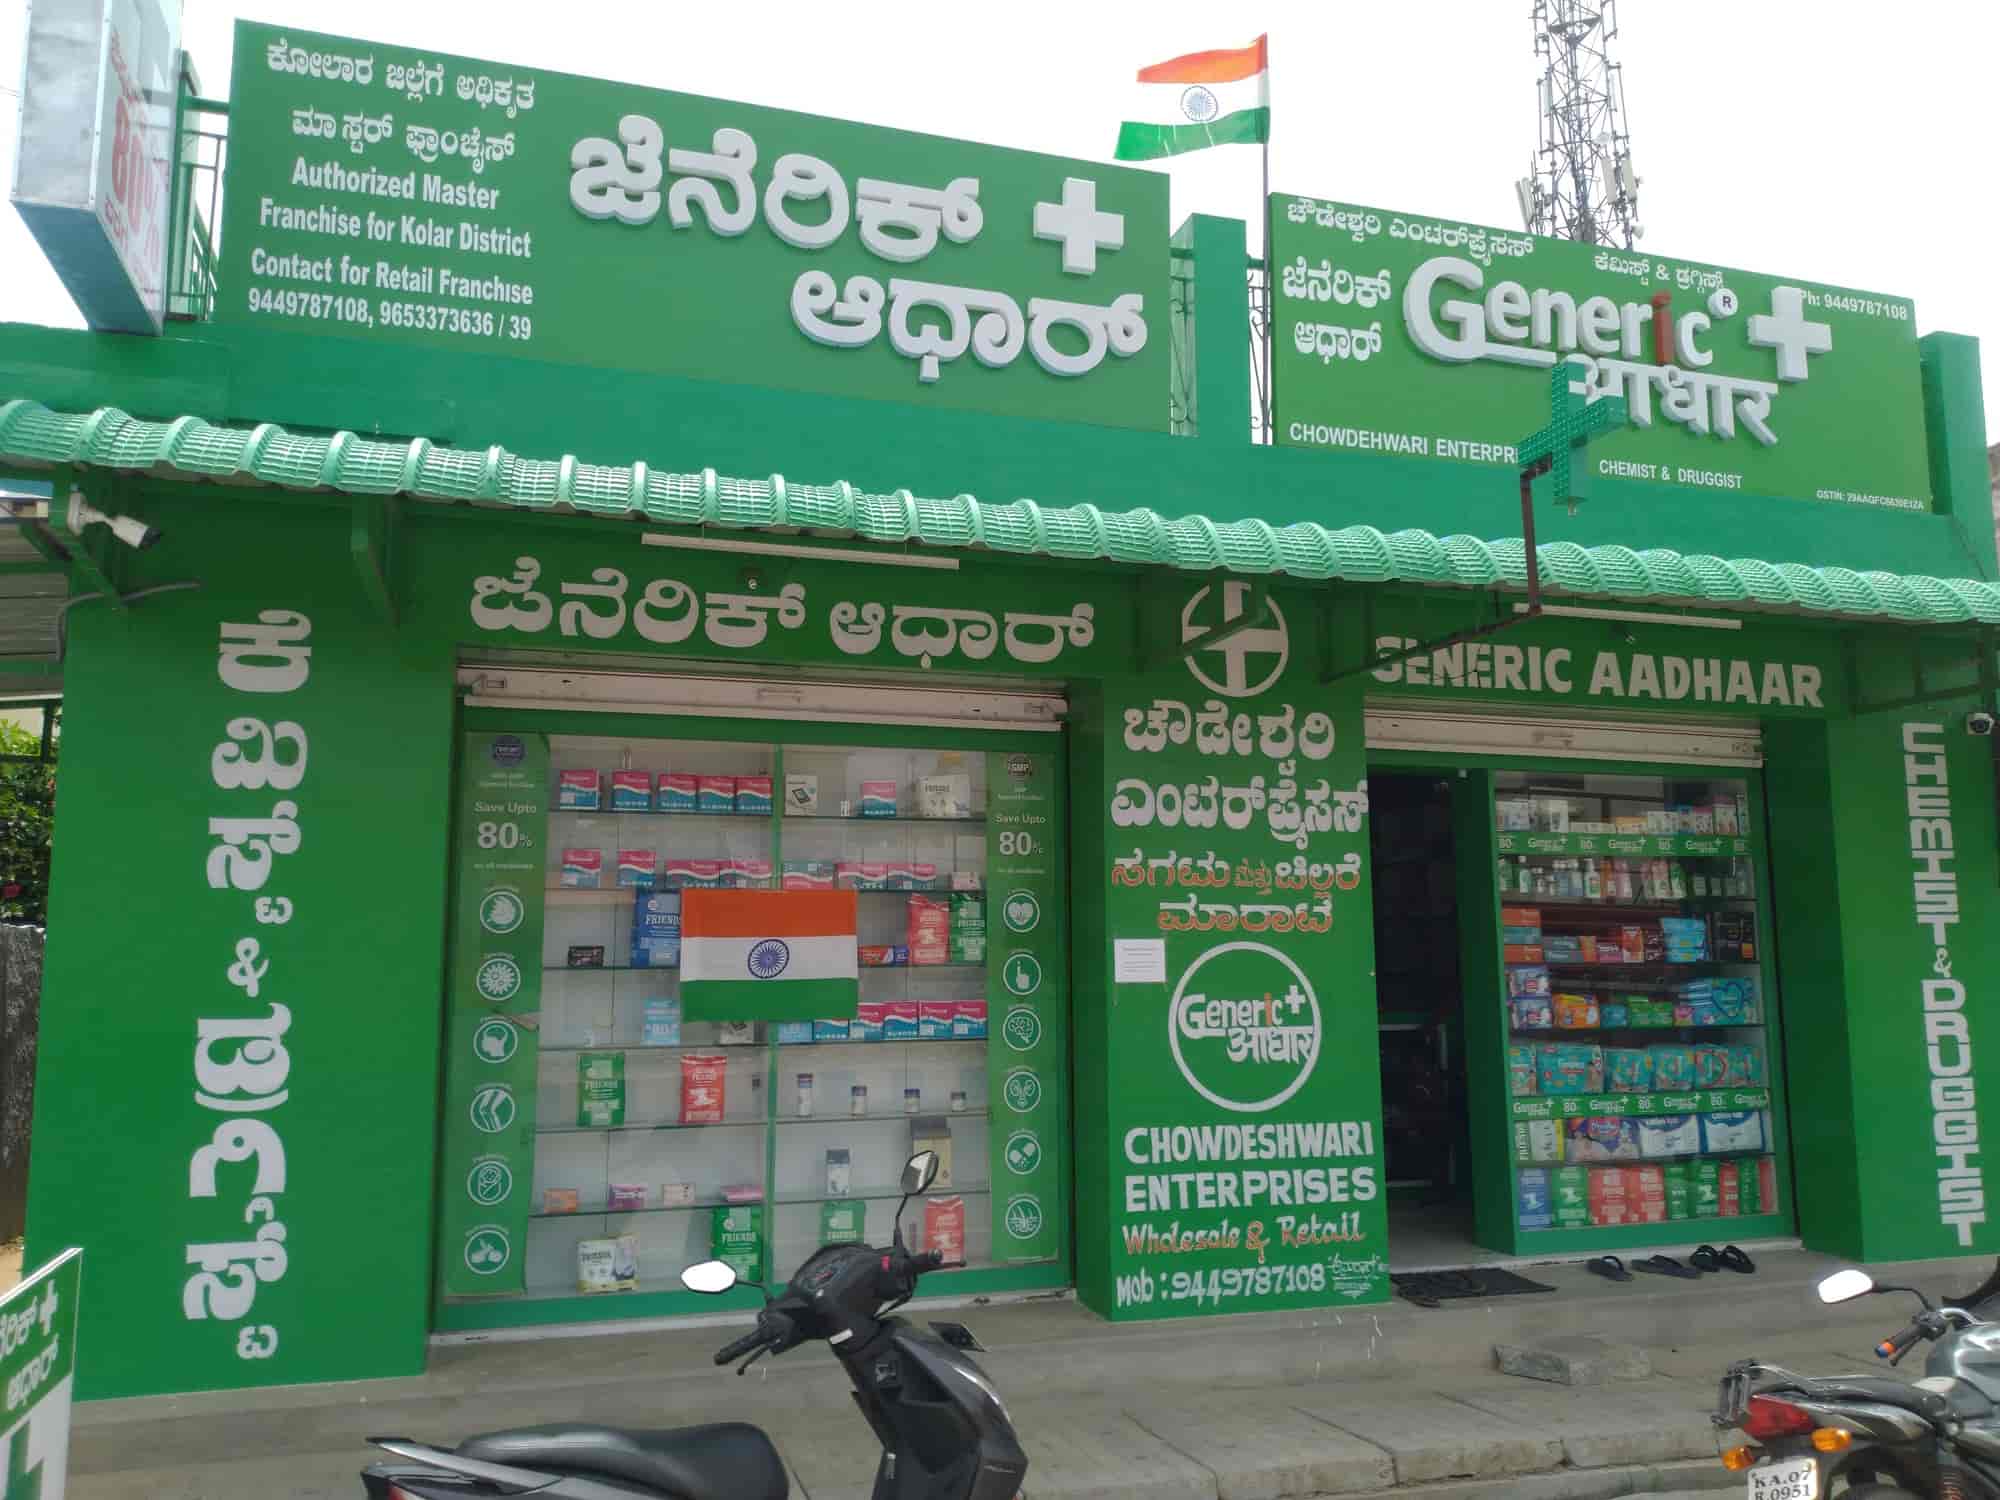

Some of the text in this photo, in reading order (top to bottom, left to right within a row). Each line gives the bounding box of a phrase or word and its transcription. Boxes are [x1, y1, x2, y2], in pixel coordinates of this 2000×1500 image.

[267, 38, 535, 119] ಕೋಲಾರ ಜಿಲ್ಲೆಗೆ ಅಧಿಕೃತ
[292, 156, 499, 209] Authorized Master
[570, 115, 984, 263] ಜೆನೆರಿಕ್
[260, 198, 531, 258] Franchise for Kolar District
[251, 248, 533, 304] Contact for Retail Franchise
[1656, 264, 1670, 281] &
[249, 288, 532, 340] 9449787108, 9653373636 / 39
[791, 270, 1148, 383] ಆಧಾರ್
[1402, 256, 1714, 369] Generic
[1825, 294, 1908, 321] 9449787108
[1294, 321, 1382, 365] ಆಧಾರ್
[1560, 352, 1779, 446] आधार
[1290, 422, 1428, 456] CHOWDEHWARI
[1599, 459, 1743, 489] CHEMIST & DRUGGIST
[470, 556, 1095, 669] ಜೆನೆರಿಕ್ ಆಧಾರ್
[1372, 636, 1824, 708] GENERIC AADHAAR
[474, 801, 537, 815] Save Upto
[996, 814, 1047, 826] Save Upto
[477, 822, 533, 849] 80%
[1111, 848, 1231, 888] ಸಗಟು
[646, 914, 681, 925] FRIEND
[1157, 893, 1332, 933] ಮಾರಾಟ
[227, 937, 269, 998] &
[1902, 722, 1986, 1246] CHEMIST & DRUGGIST
[1178, 992, 1283, 1040] Generic
[1227, 1025, 1315, 1064] आधार
[1124, 1121, 1375, 1165] CHOWDESHWARI
[1125, 1166, 1377, 1212] ENTERPRISES
[1122, 1211, 1366, 1264] Wholesale & Retail
